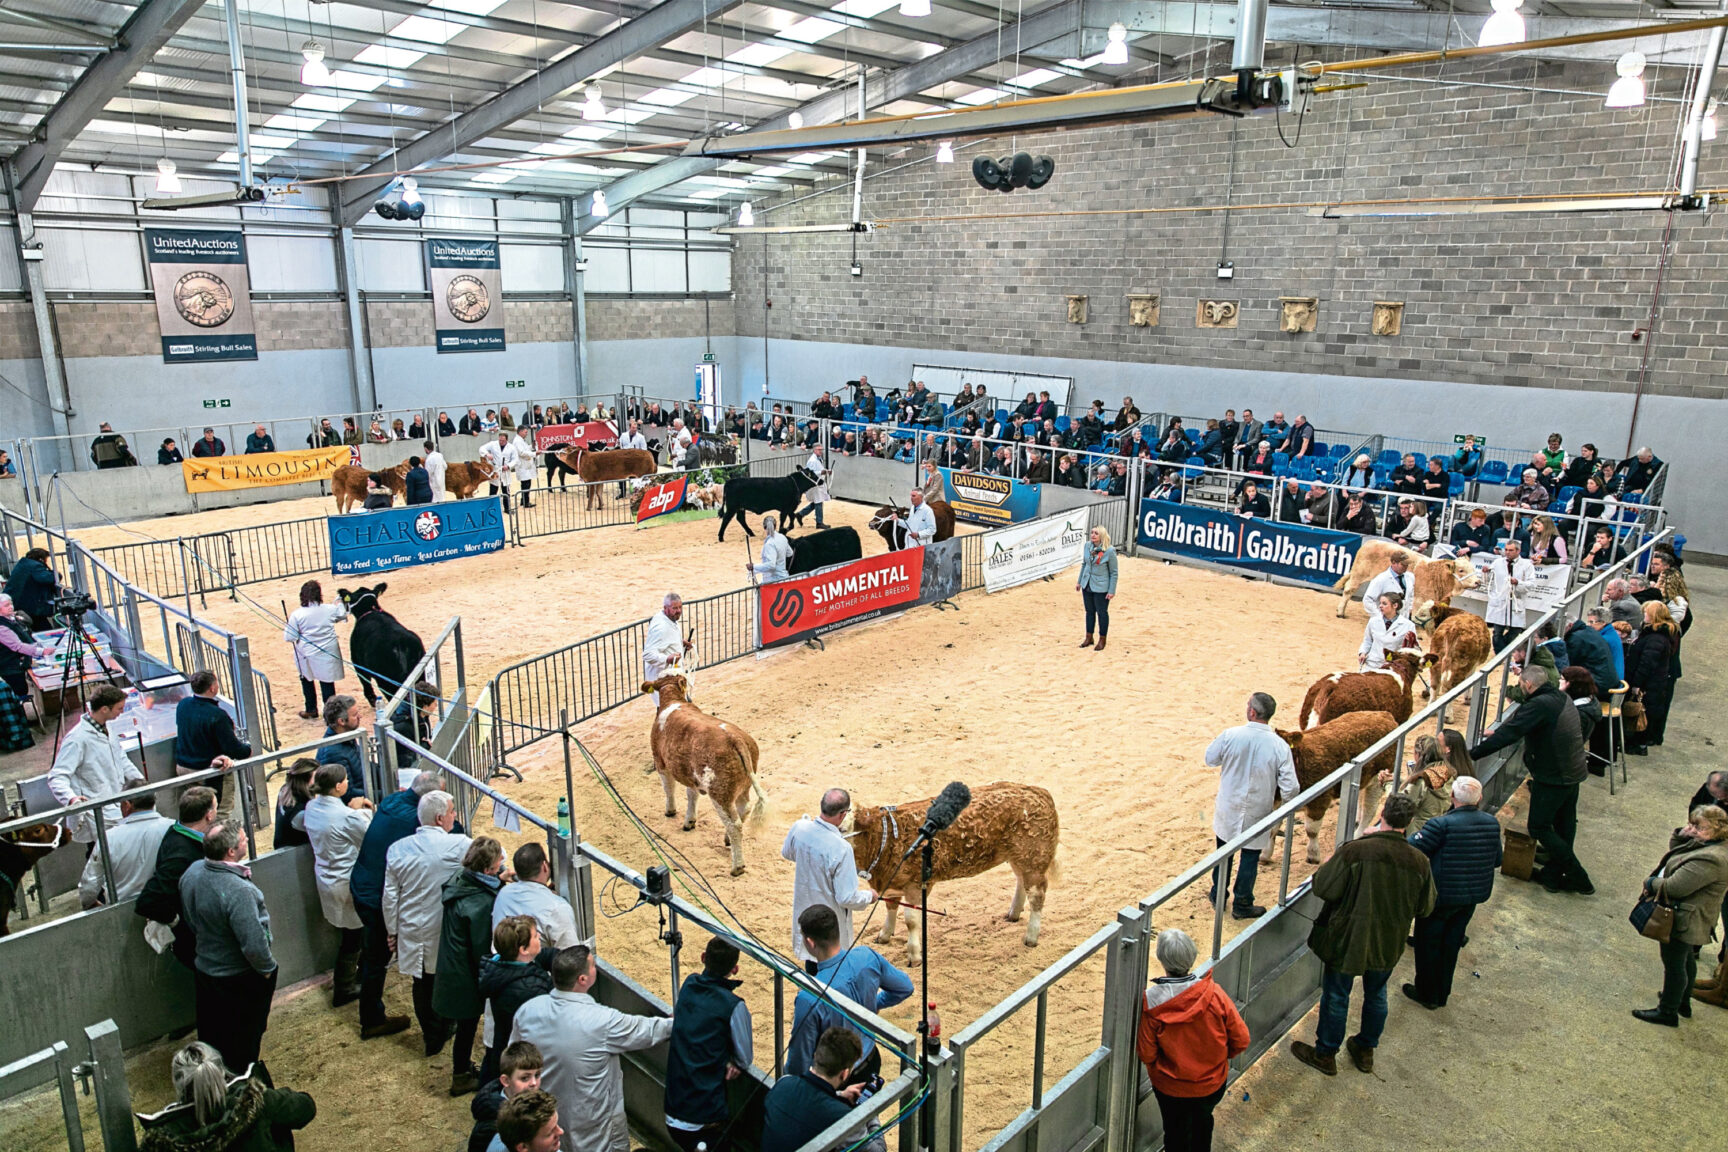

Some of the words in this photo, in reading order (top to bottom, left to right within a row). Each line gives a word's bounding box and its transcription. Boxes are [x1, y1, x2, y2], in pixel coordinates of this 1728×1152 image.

[153, 236, 238, 249] UnitedAuctions
[433, 246, 495, 256] UnitedAuctions
[195, 345, 220, 353] Stirling
[220, 344, 234, 352] Bull
[221, 456, 337, 480] LIMOUSIN
[954, 474, 1009, 493] DAVIDSONS
[964, 488, 981, 498] Animal
[648, 484, 675, 512] abp
[1061, 531, 1083, 545] DALES
[1143, 510, 1235, 554] Galbraith
[336, 561, 352, 572] Less
[353, 559, 371, 569] Feed
[376, 557, 392, 567] Less
[392, 554, 412, 563] Time
[418, 551, 432, 562] Less
[433, 548, 458, 558] Carbon
[464, 543, 481, 552] More
[482, 539, 502, 549] Profit
[988, 551, 1013, 566] DALES
[1246, 530, 1352, 576] Galbraith
[811, 564, 909, 605] SIMMENTAL
[815, 606, 827, 616] THE
[828, 597, 858, 612] MOTHER
[859, 594, 868, 603] OF
[870, 592, 883, 600] ALL
[885, 584, 910, 596] BREEDS
